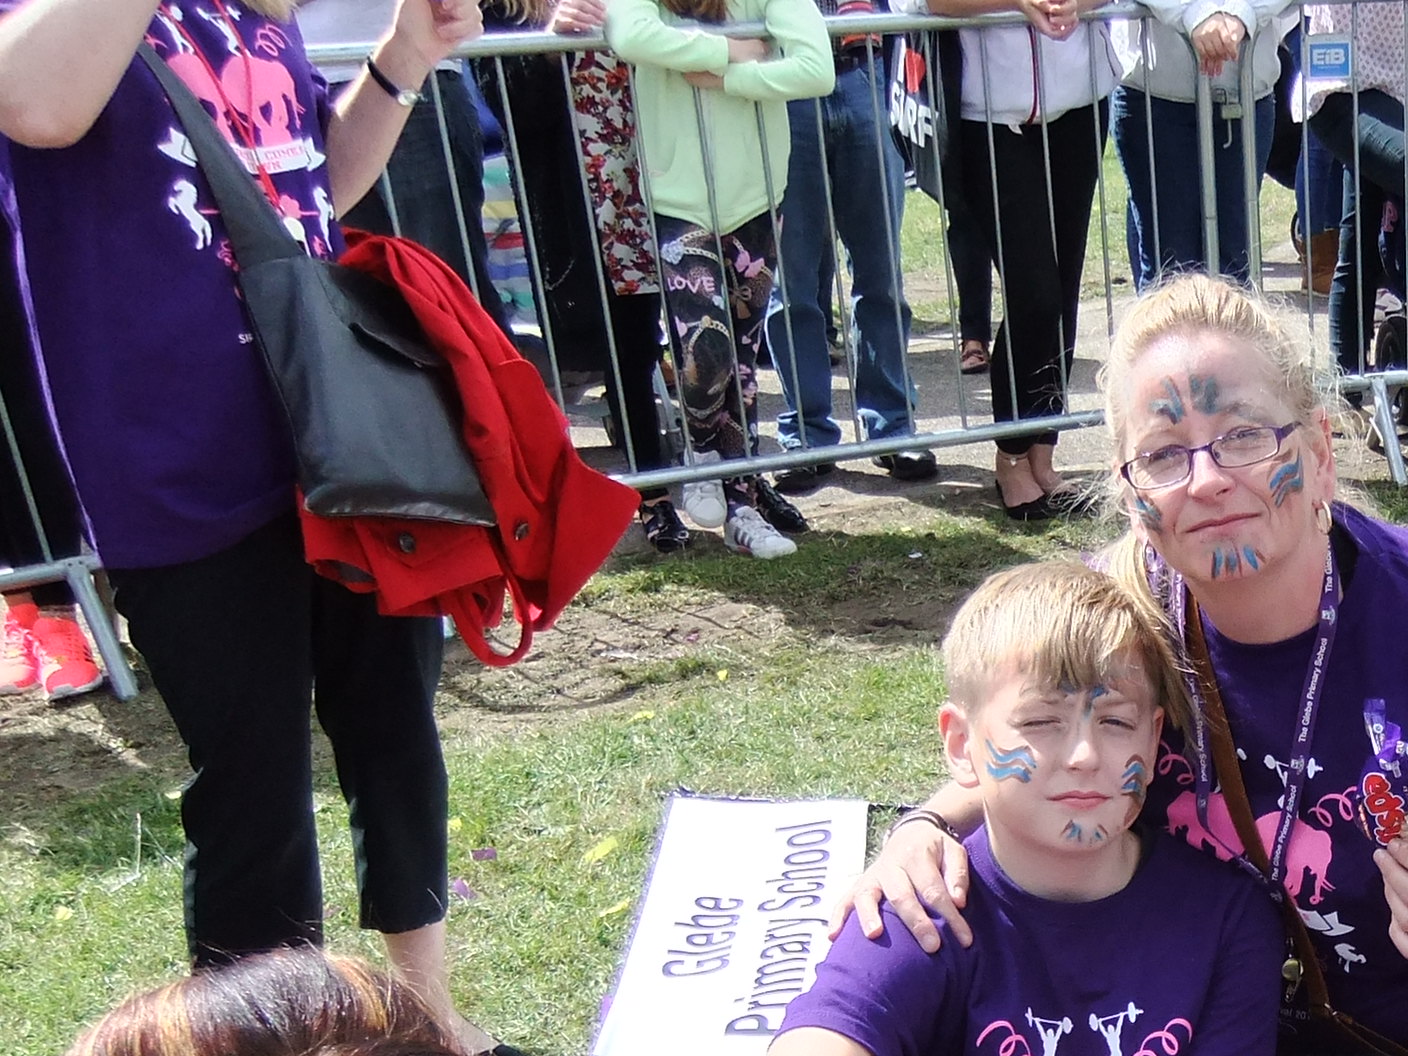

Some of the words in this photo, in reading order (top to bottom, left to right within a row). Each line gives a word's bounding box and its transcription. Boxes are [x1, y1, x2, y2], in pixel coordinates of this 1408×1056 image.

[667, 275, 715, 294] LOVE
[1314, 638, 1328, 667] School
[1306, 667, 1322, 700] Primary
[1301, 701, 1313, 726] Glebe
[1298, 727, 1309, 743] The
[1271, 867, 1280, 881] The
[1278, 812, 1293, 844] Primary
[1286, 784, 1298, 813] School
[757, 819, 832, 912] School
[662, 896, 744, 978] Glebe
[724, 917, 829, 1036] Primary
